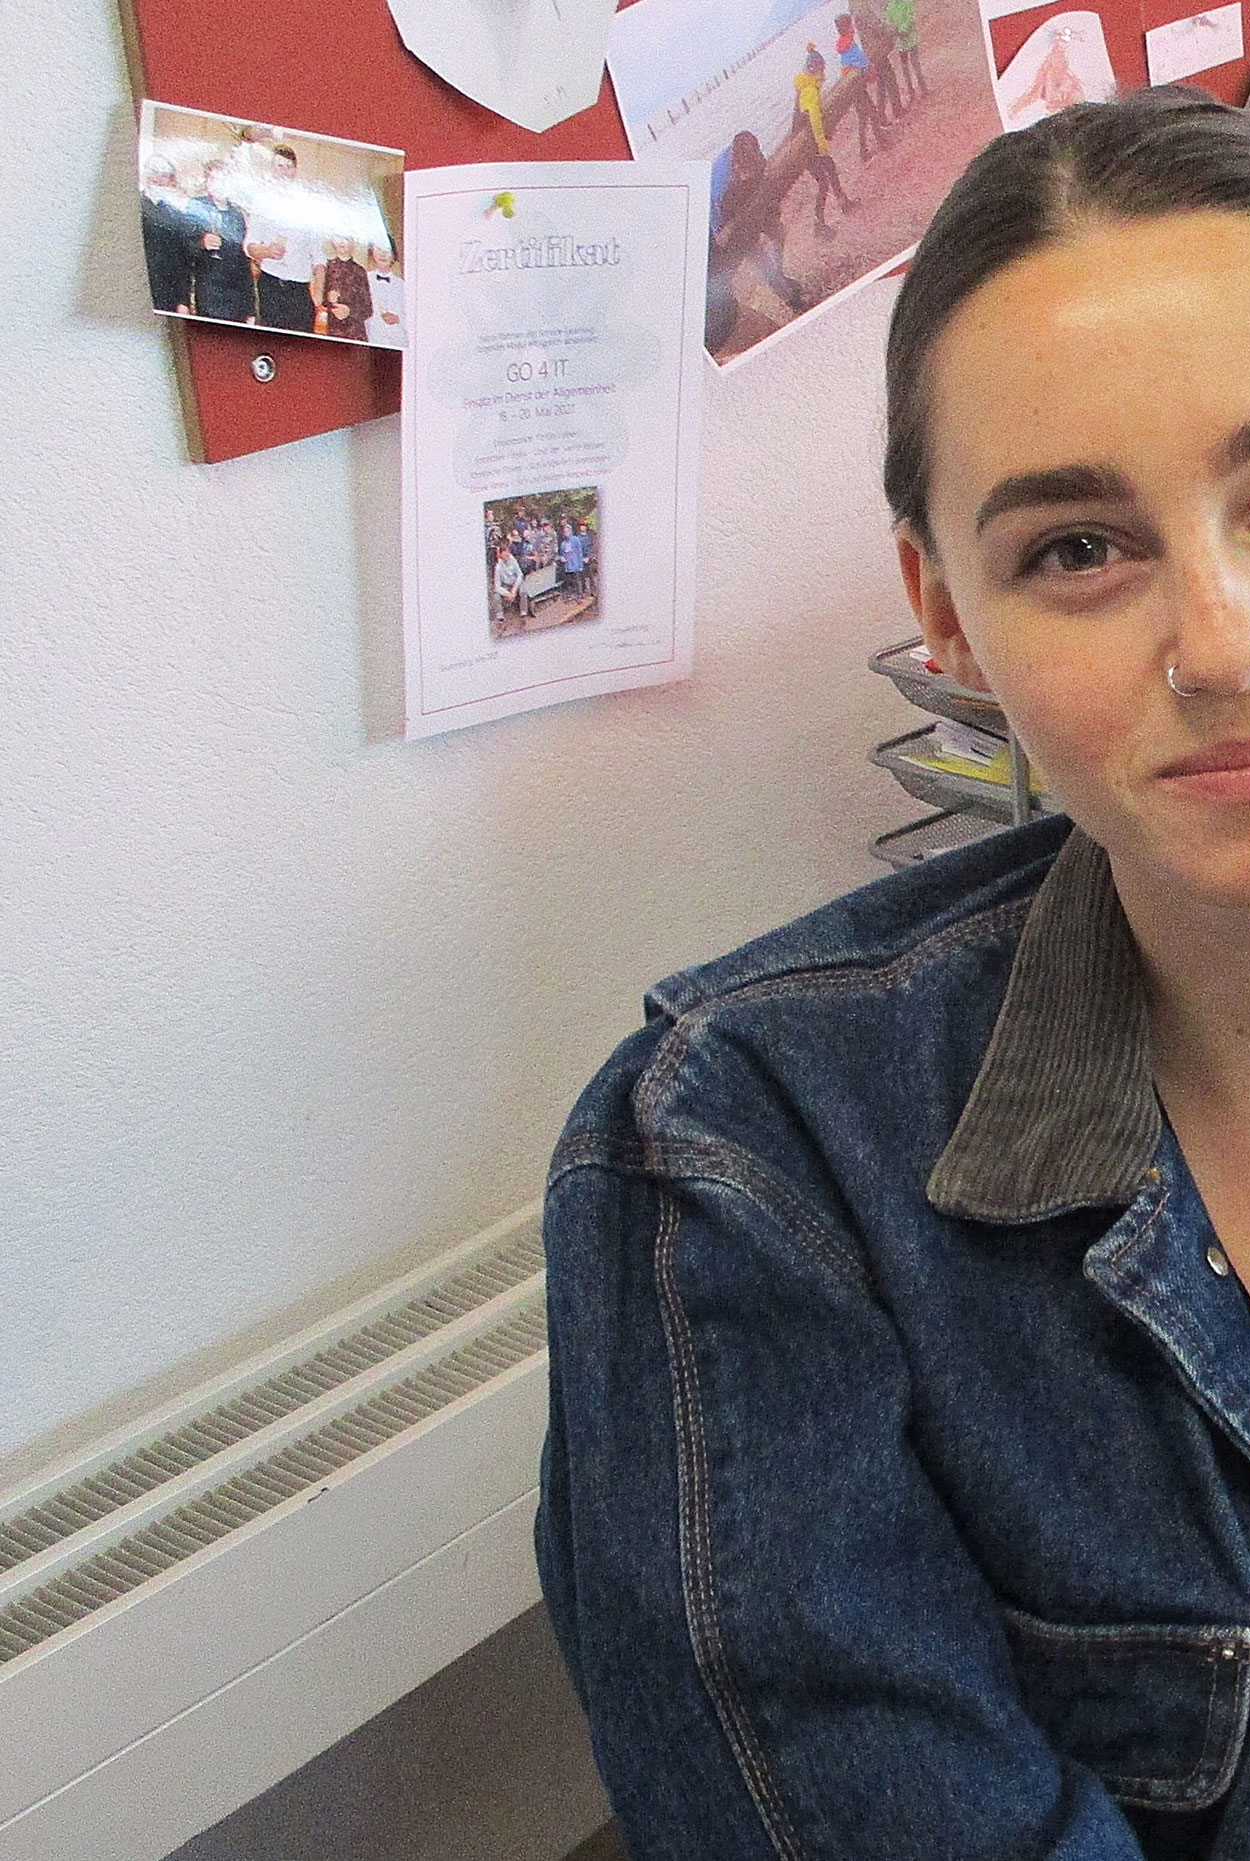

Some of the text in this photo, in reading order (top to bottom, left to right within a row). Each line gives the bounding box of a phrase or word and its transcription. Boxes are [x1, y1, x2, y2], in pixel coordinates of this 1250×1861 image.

[459, 234, 620, 275] Zertifikat
[506, 359, 569, 383] GO 4 IT
